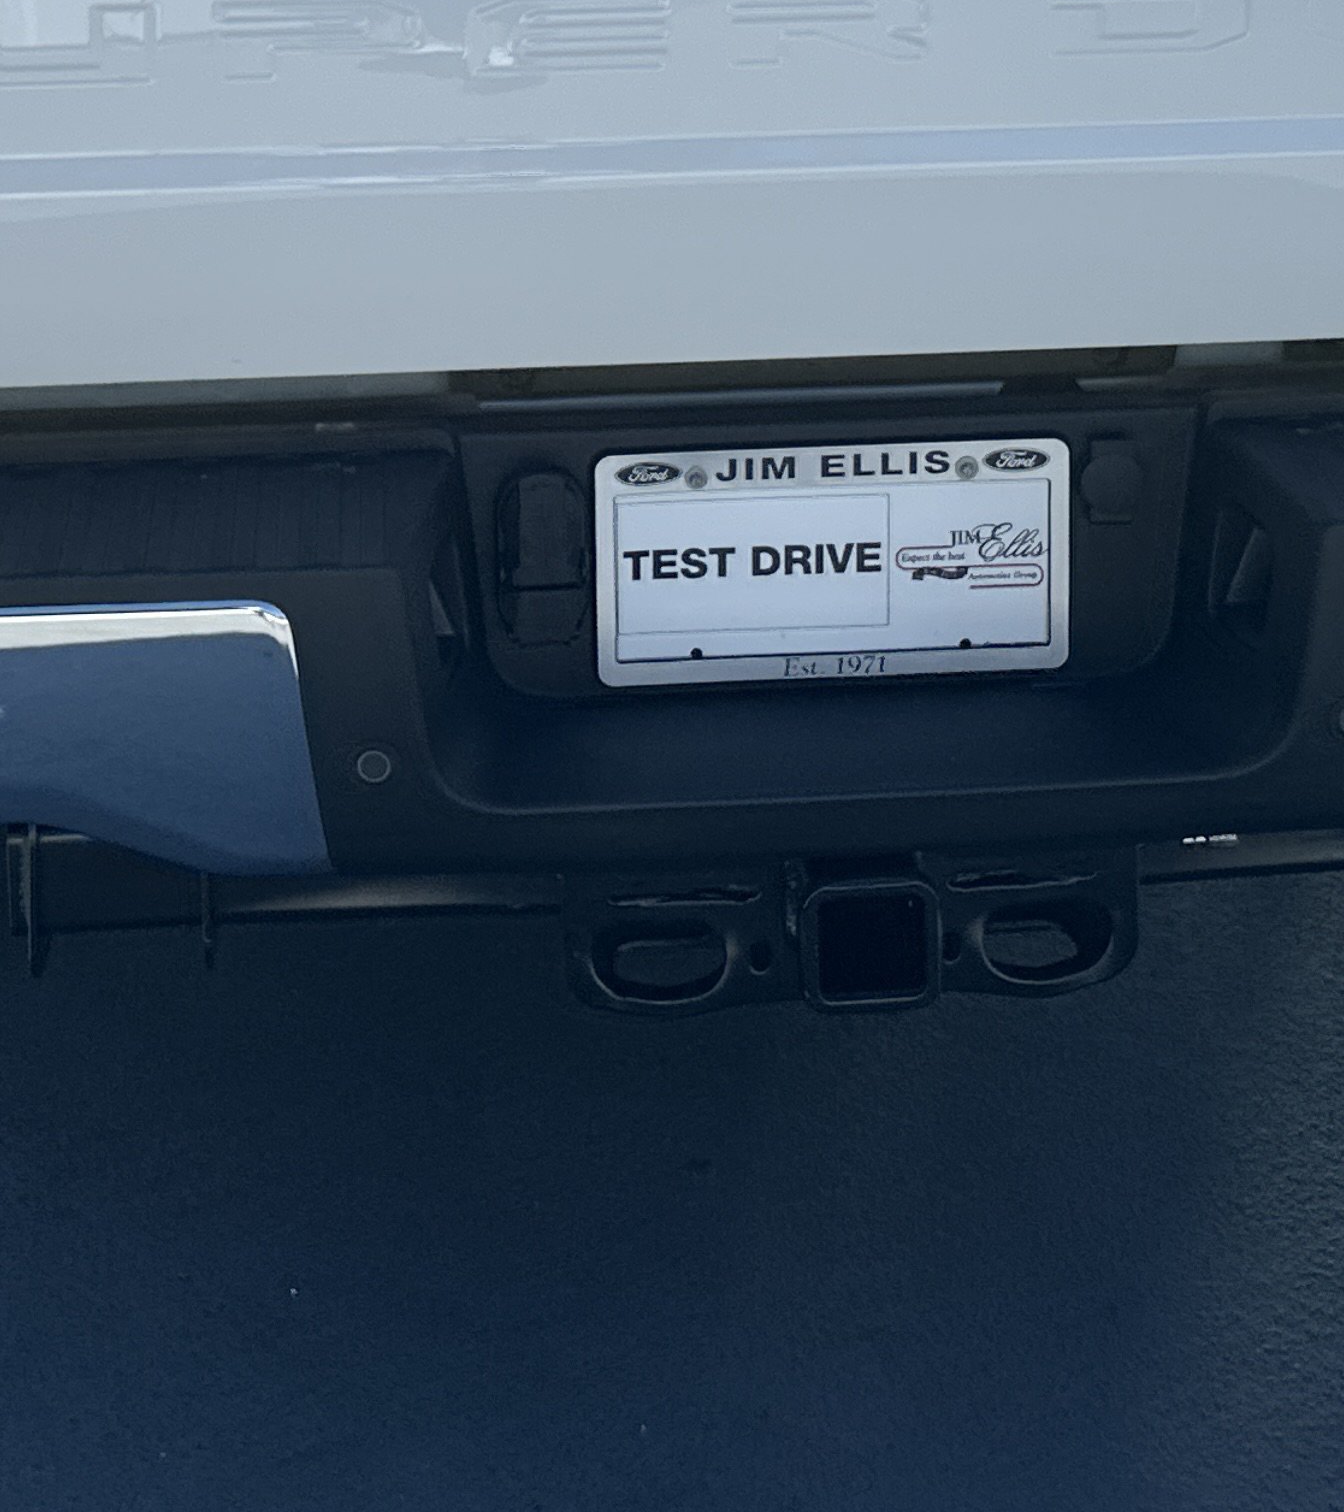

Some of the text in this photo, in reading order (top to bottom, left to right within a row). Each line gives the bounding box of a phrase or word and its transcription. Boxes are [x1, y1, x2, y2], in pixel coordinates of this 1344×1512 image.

[715, 450, 950, 482] JIM ELLIS
[995, 450, 1037, 468] Ford
[628, 465, 670, 482] Ford
[950, 522, 1048, 562] JIM Ellis
[623, 542, 882, 580] TEST DRIVE
[783, 655, 886, 678] Est. 1971
